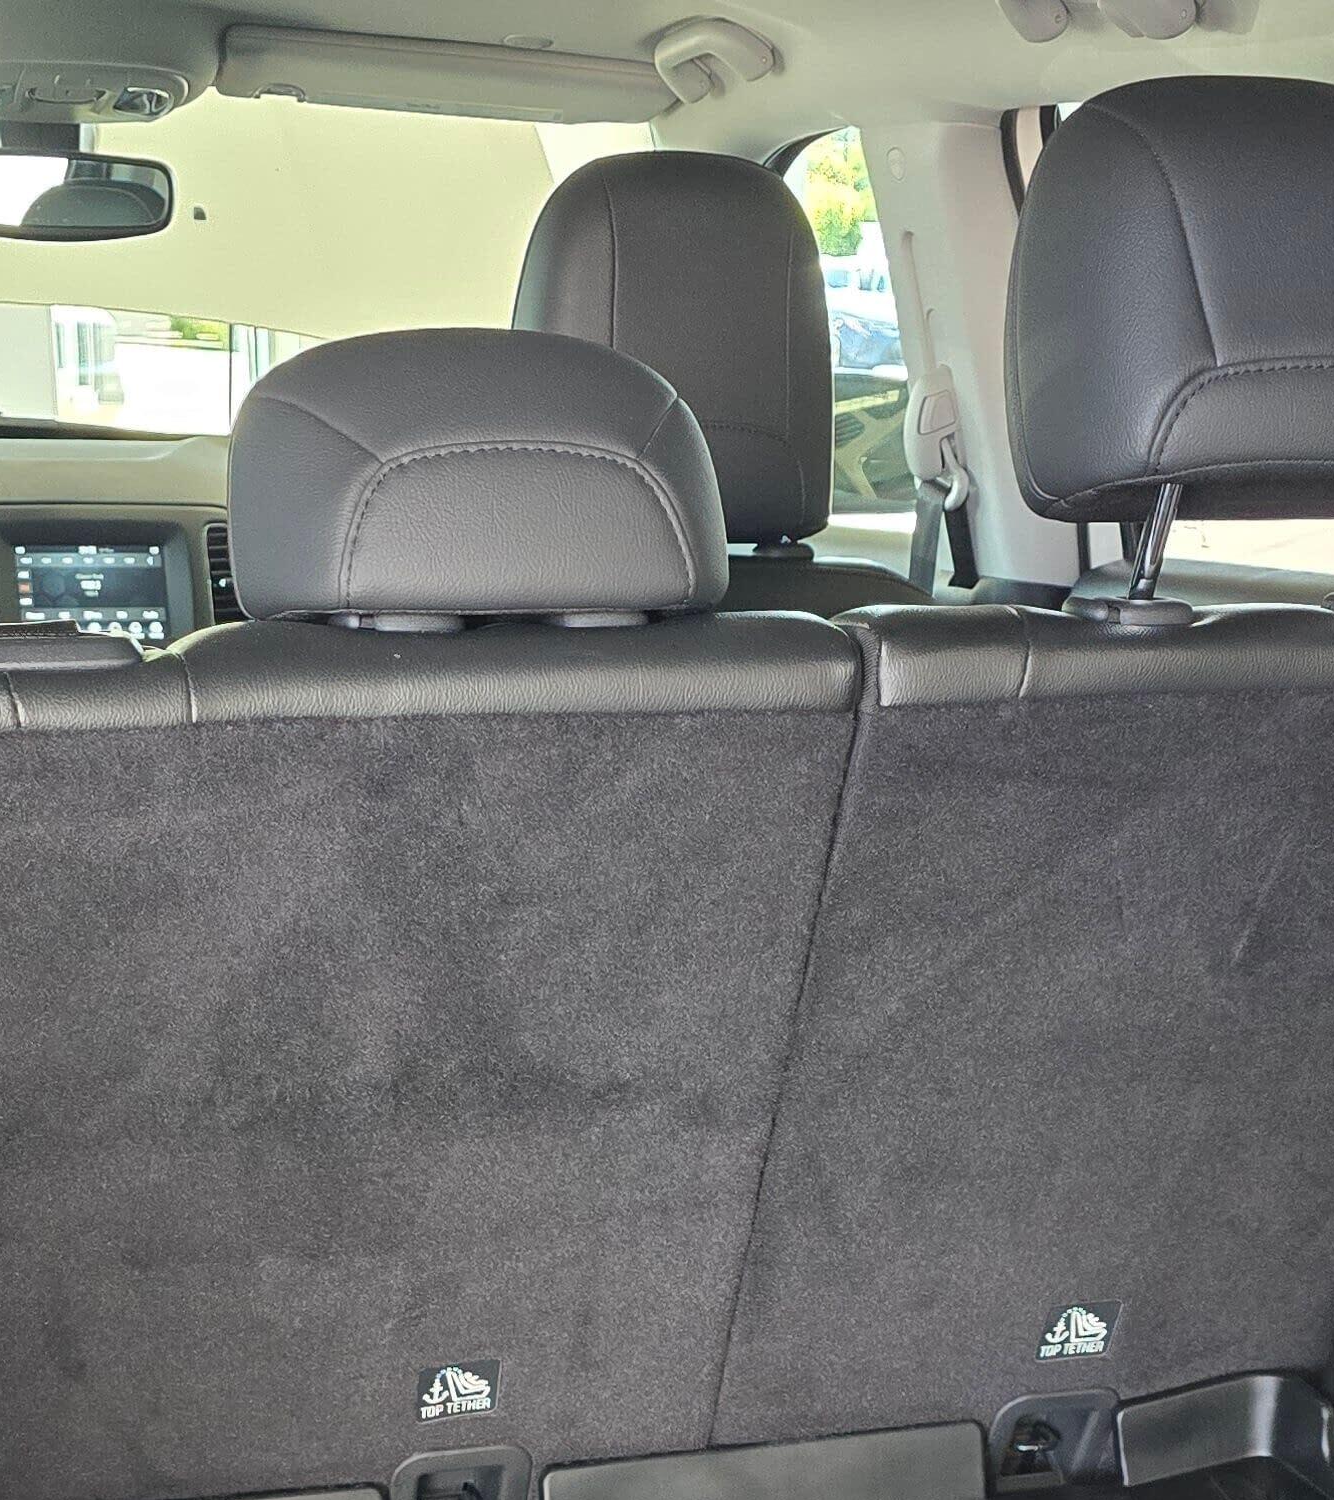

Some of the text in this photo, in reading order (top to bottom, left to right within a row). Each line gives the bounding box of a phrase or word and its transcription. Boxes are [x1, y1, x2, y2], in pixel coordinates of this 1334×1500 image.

[1039, 1340, 1105, 1358] TOP TETHER
[420, 1397, 491, 1419] TOP TETHER
